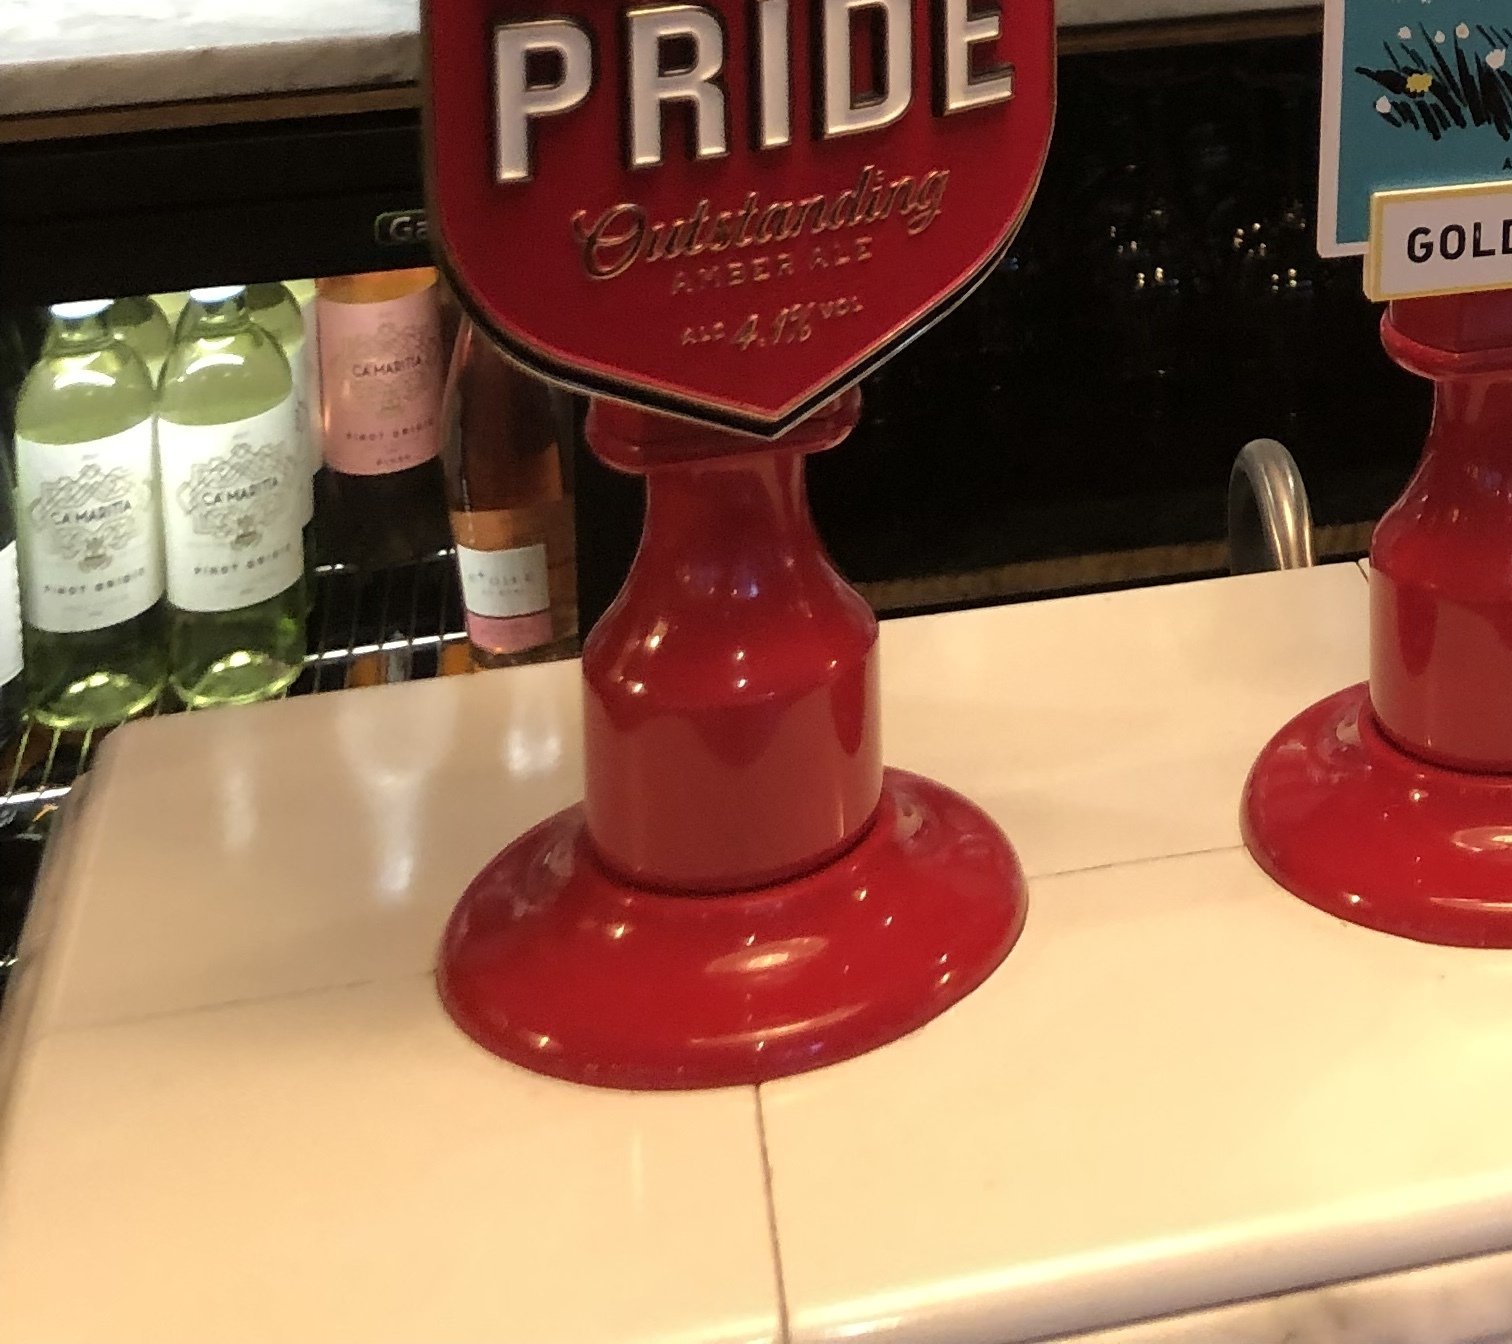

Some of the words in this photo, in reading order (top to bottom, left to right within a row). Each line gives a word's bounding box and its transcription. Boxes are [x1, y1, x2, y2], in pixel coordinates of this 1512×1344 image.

[570, 164, 953, 281] Outstanding
[670, 253, 797, 297] AMBER
[810, 236, 875, 271] ALE
[680, 321, 726, 348] ALC
[735, 302, 814, 354] 4.1%
[819, 296, 867, 321] VOL
